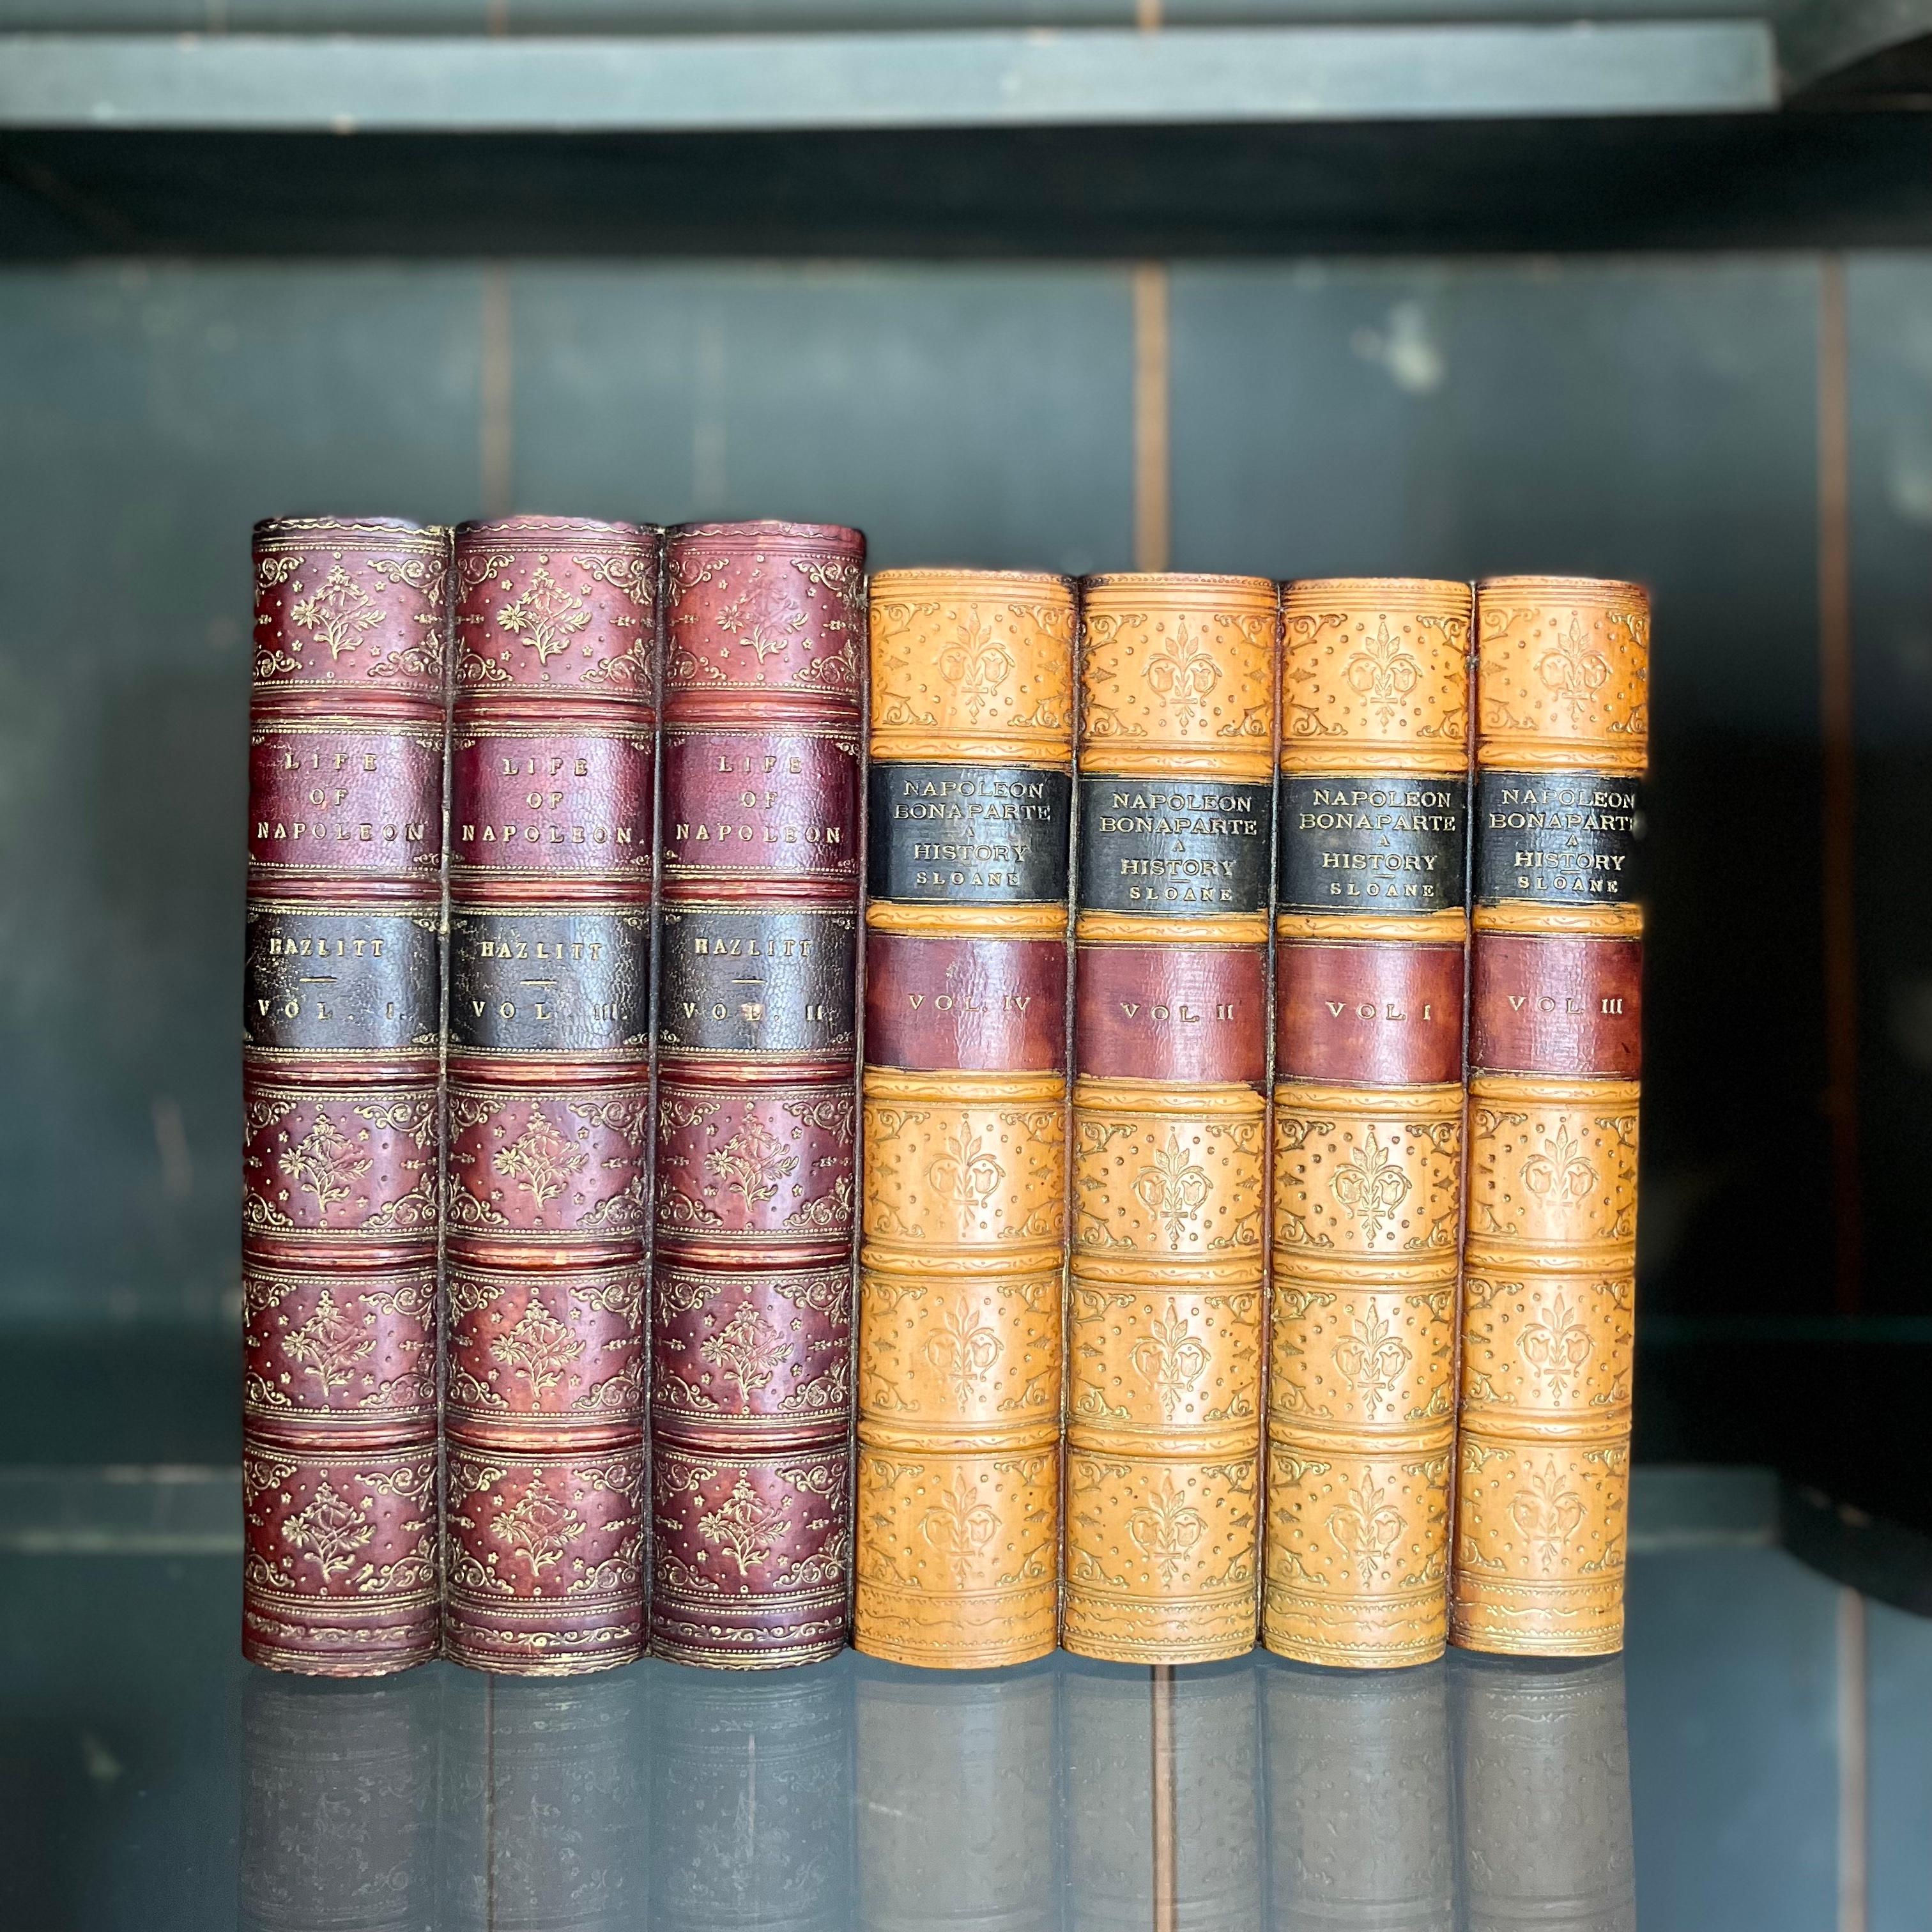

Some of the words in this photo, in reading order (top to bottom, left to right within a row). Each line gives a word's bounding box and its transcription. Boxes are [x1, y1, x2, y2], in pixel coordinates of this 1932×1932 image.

[285, 753, 376, 771] LIFE
[503, 758, 588, 776] LIFE
[718, 755, 802, 773] LIFE
[310, 788, 348, 805] OF
[903, 780, 1044, 799] NAPOLEON
[1313, 789, 1451, 808] NAPOLEON
[1502, 789, 1635, 808] NAPOLEON
[526, 792, 564, 809] OF
[741, 791, 778, 809] OF
[1112, 792, 1252, 812] NAPOLEON
[894, 803, 1051, 822] BONAPARTE
[1100, 816, 1257, 835] BONAPARTE
[1299, 813, 1455, 831] BONAPARTE
[257, 822, 424, 841] NAPOLEON
[676, 824, 841, 843] NAPOLEON
[965, 825, 976, 838] A
[1377, 834, 1390, 847] A
[1567, 834, 1579, 847] A
[914, 843, 1030, 862] HISTORY
[1172, 839, 1185, 852] A
[1121, 858, 1236, 877] HISTORY
[1322, 852, 1438, 871] HISTORY
[1514, 850, 1625, 871] HISTORY
[916, 871, 1021, 886] SLOANE
[1518, 876, 1618, 893] SLOANE
[1130, 885, 1233, 901] SLOANE
[1330, 882, 1434, 897] SLOANE
[270, 937, 384, 957] HAZLITT
[481, 941, 602, 960] HAZLITT
[694, 938, 811, 956] HAZLITT
[1003, 995, 1032, 1011] IV
[1600, 998, 1623, 1015] III
[1216, 1004, 1234, 1021] II
[1423, 1004, 1432, 1021] I
